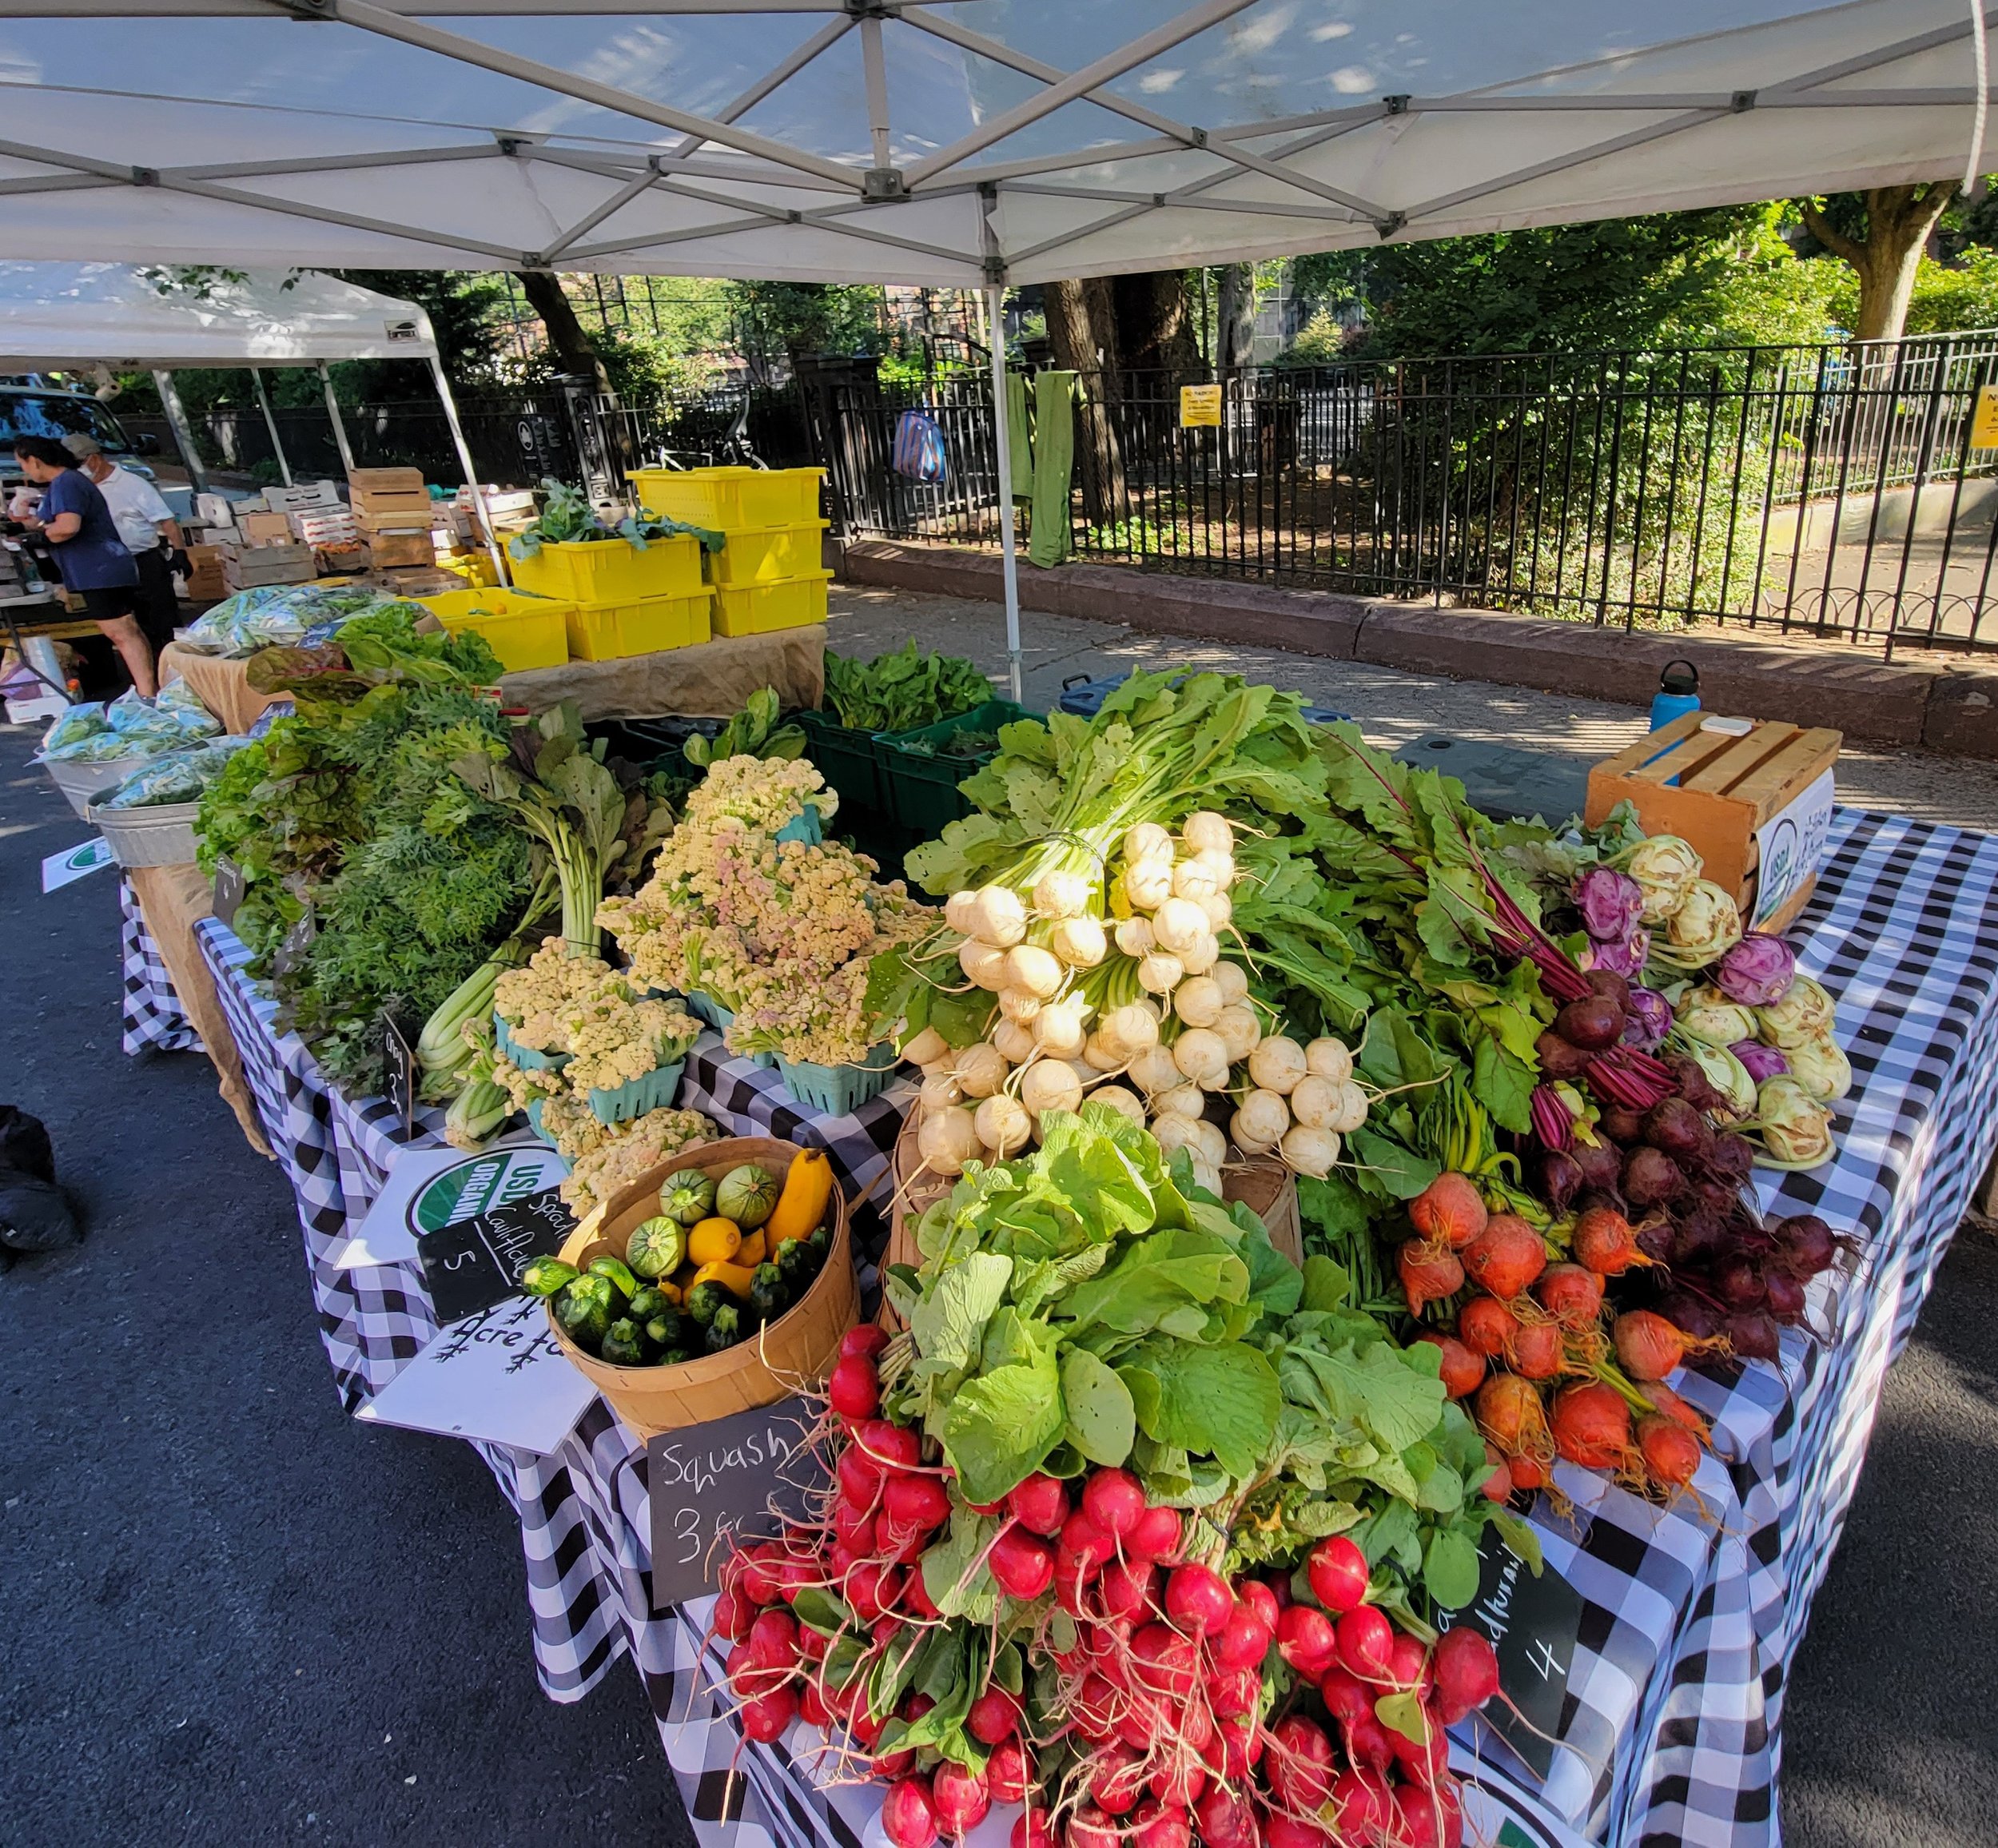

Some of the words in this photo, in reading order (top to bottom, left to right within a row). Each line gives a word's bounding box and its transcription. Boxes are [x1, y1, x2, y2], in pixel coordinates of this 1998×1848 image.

[444, 1162, 500, 1228] ORGANI
[495, 1164, 544, 1209] USD
[444, 1250, 476, 1270] 5
[662, 1427, 790, 1496] Squash
[675, 1507, 701, 1563] 3
[1526, 1639, 1566, 1682] 4
